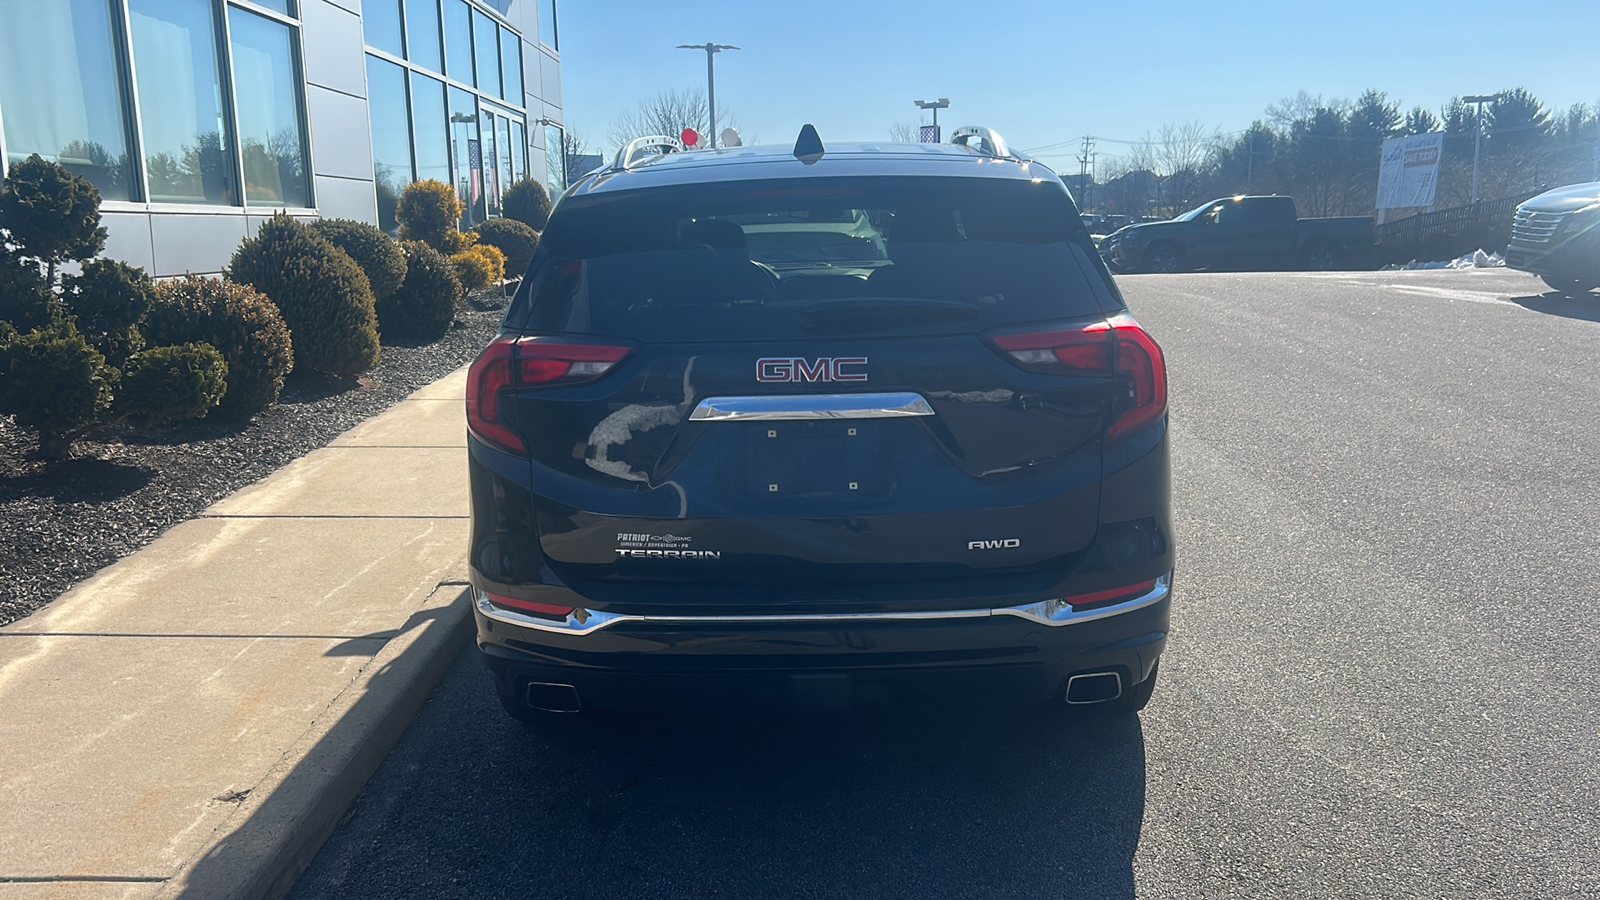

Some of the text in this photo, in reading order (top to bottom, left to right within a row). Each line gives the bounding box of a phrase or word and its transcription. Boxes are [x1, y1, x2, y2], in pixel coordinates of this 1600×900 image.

[755, 356, 868, 383] GMC
[617, 533, 651, 542] PATRIOT
[968, 538, 1020, 550] AWD
[615, 549, 720, 559] TERRAIN
